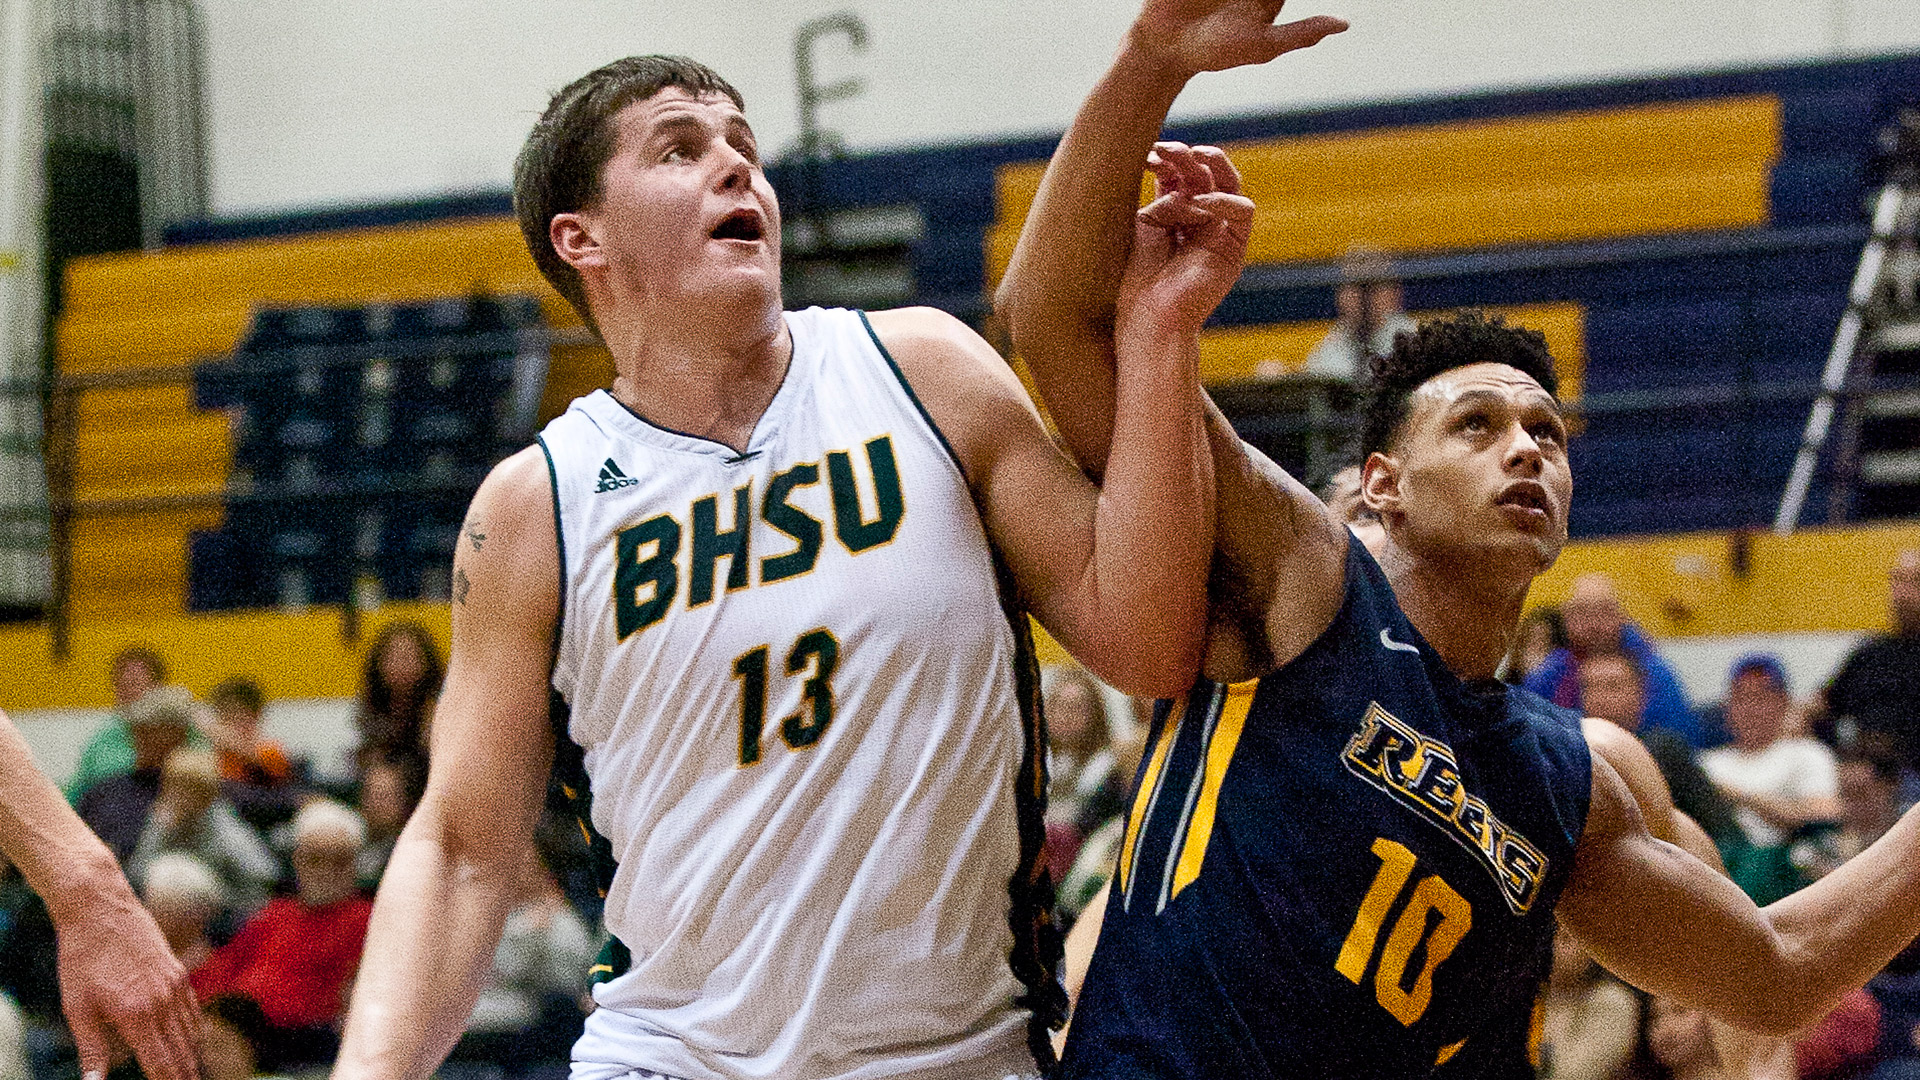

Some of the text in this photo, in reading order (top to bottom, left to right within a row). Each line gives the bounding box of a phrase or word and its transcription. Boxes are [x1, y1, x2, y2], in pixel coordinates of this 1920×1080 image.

[612, 432, 907, 645] BHSU
[731, 625, 842, 770] 13
[1334, 836, 1473, 1028] 10
